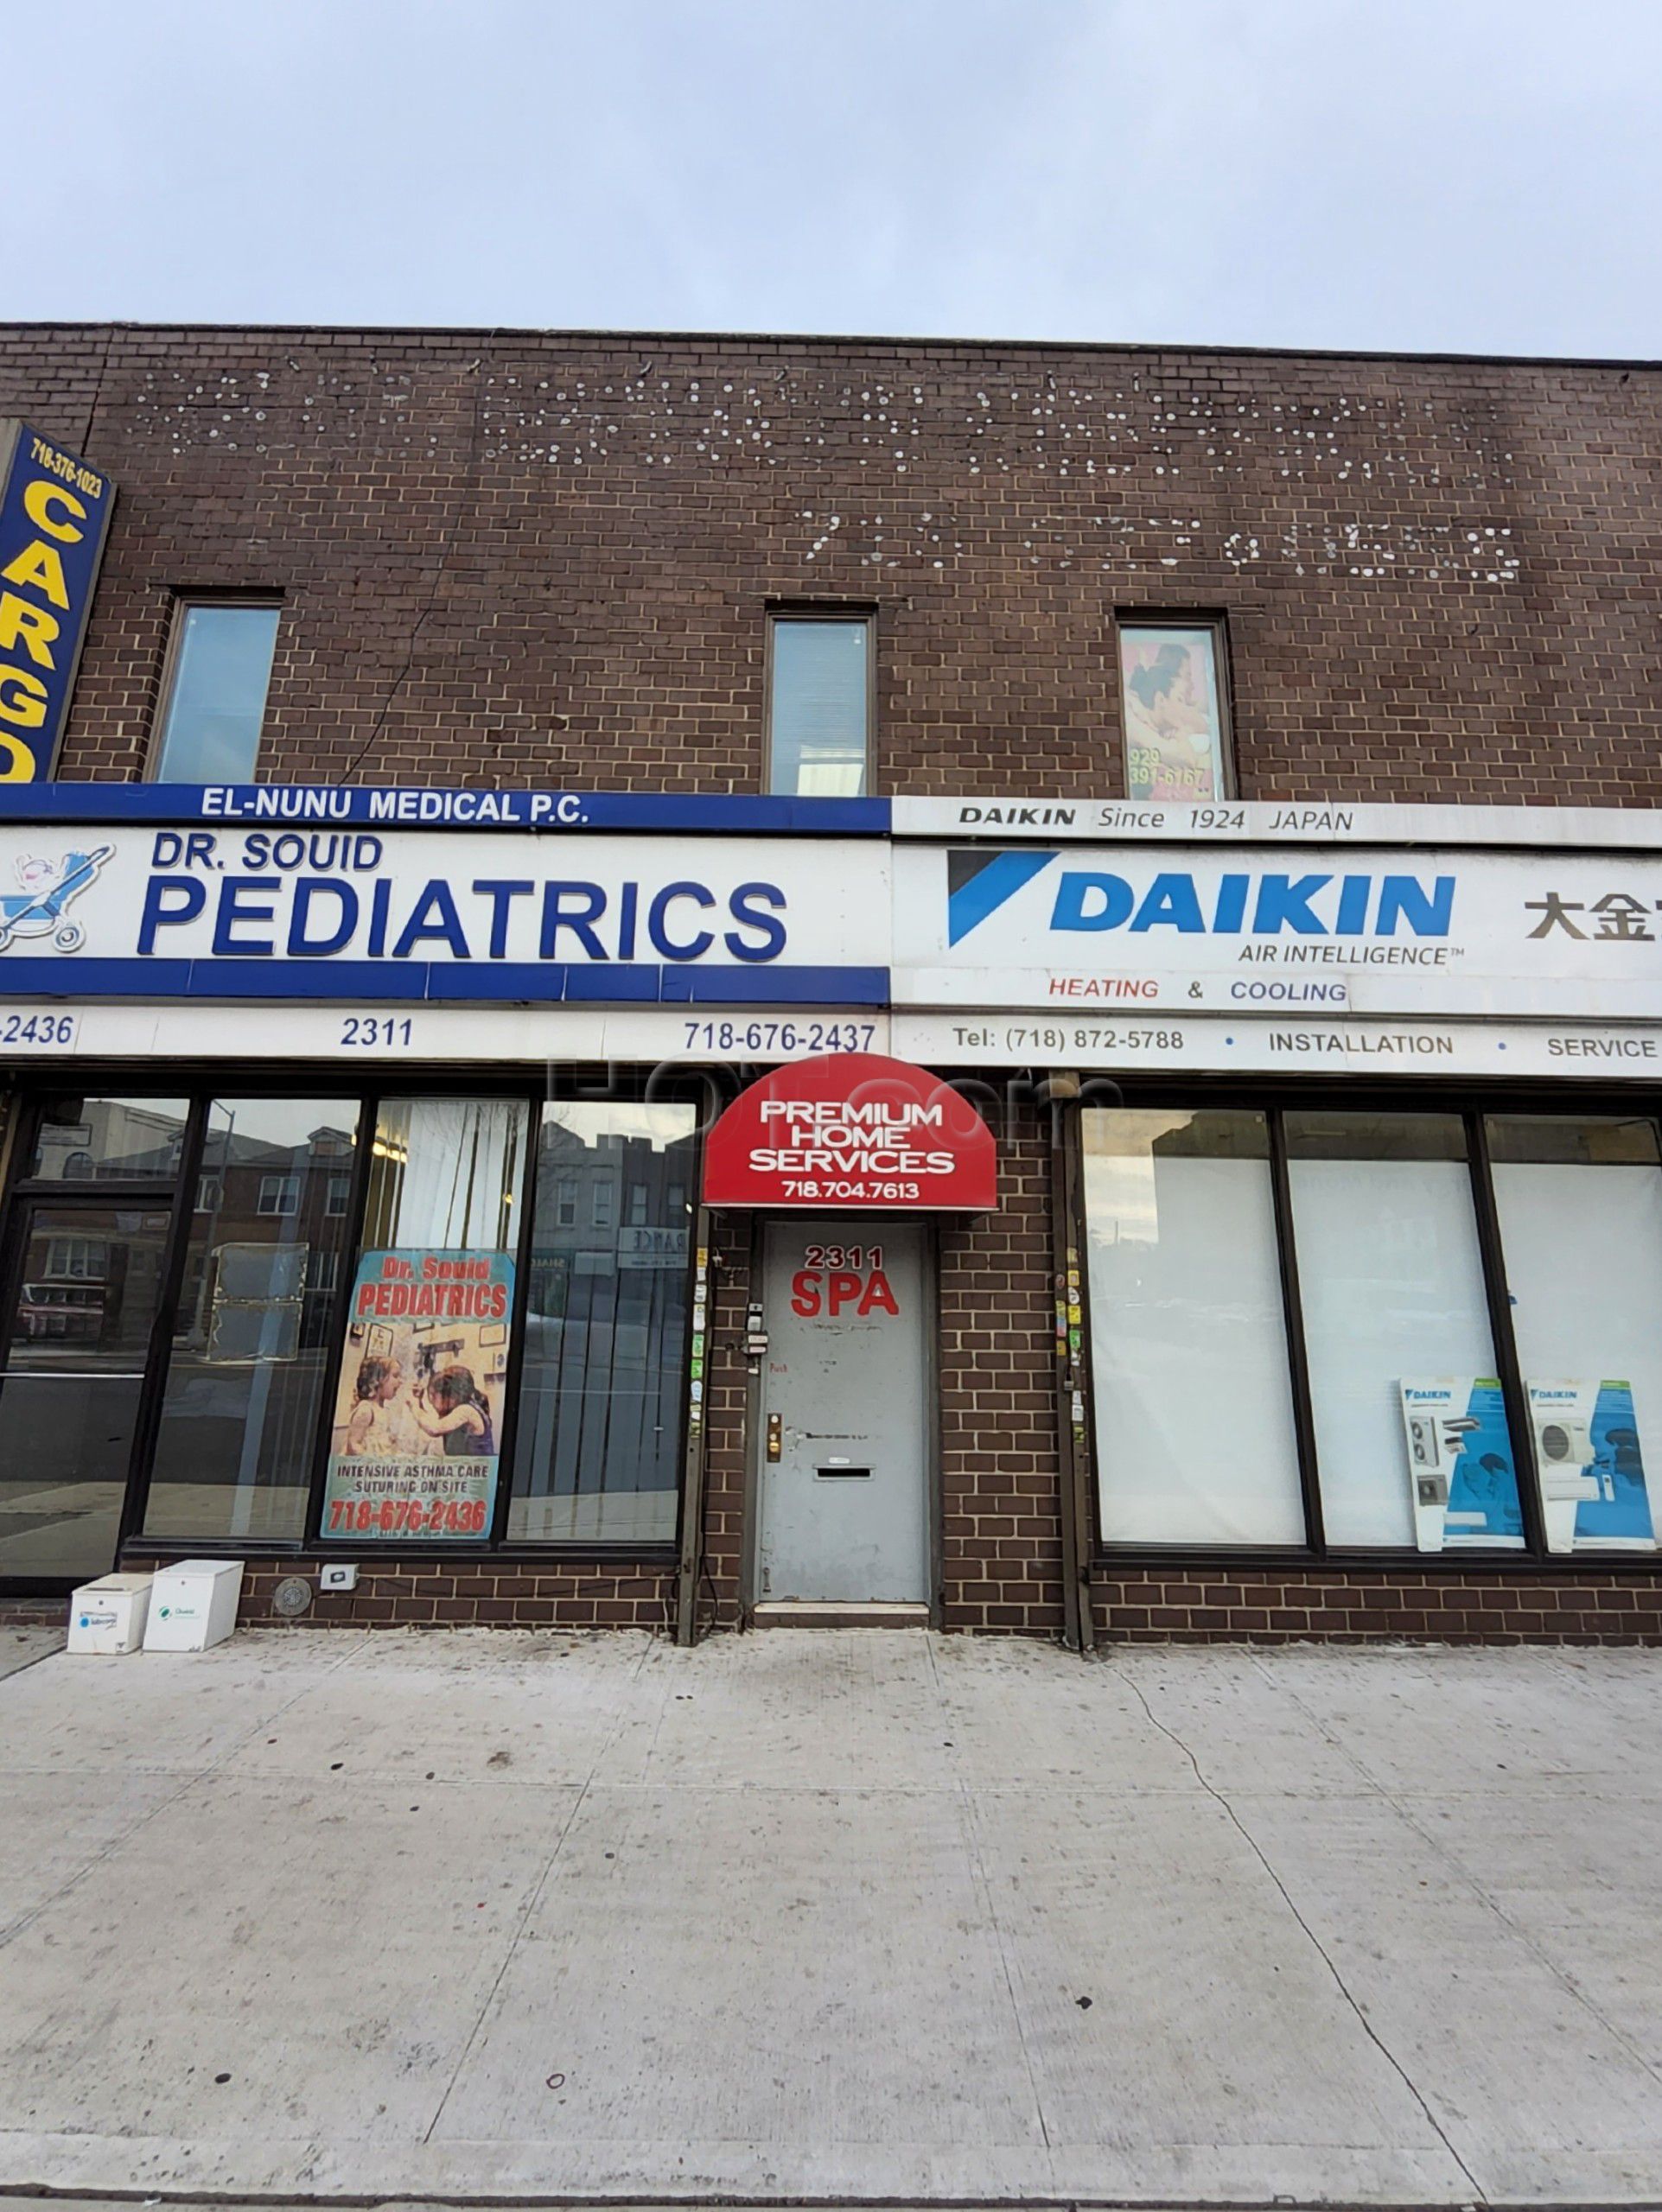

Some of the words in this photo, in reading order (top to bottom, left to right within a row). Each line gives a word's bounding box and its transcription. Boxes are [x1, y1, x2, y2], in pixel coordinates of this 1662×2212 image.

[31, 437, 103, 499] 718-376-1023
[1130, 747, 1161, 766] 929
[201, 787, 352, 818] EL-NUNU
[369, 791, 520, 823] MEDICAL
[529, 793, 589, 823] P.C.
[958, 806, 1077, 826] DAIKIN
[1098, 806, 1165, 828] Since
[1189, 809, 1246, 830] 1924
[1268, 810, 1354, 831] JAPAN
[150, 831, 225, 869] DR.
[241, 833, 384, 872] SOUID
[1049, 871, 1456, 937] DAIKIN
[1525, 891, 1662, 942] 大金
[137, 874, 787, 963] PEDIATRICS
[1238, 944, 1277, 963] AIR
[1048, 978, 1160, 999] HEATING
[1188, 981, 1204, 1000] &
[1230, 982, 1347, 1002] COOLING
[341, 1018, 412, 1046] 2311
[684, 1022, 876, 1052] 718-676-2437
[952, 1027, 996, 1047] Tel:
[1006, 1028, 1066, 1052] (718)
[1074, 1029, 1184, 1050] 872-5788
[1270, 1033, 1454, 1054] INSTALLATION
[1547, 1039, 1658, 1058] SERVICE
[760, 1100, 943, 1127] PREMIUM
[791, 1125, 912, 1149] HOME
[748, 1148, 956, 1174] SERVICES
[780, 1179, 920, 1199] 718.704.7613
[382, 1256, 414, 1280] Dr.
[423, 1256, 491, 1281] Souid
[805, 1244, 882, 1269] 2311
[357, 1283, 507, 1319] PEDIATRICS
[791, 1270, 900, 1318] SPA
[1413, 1389, 1451, 1399] DAIKIN
[1538, 1389, 1577, 1399] DAIKIN
[337, 1465, 399, 1478] INTENSIVE
[404, 1465, 454, 1478] ASTHMA
[457, 1465, 489, 1478] CARE
[354, 1480, 417, 1493] SUTURING
[420, 1481, 438, 1493] ON
[442, 1480, 468, 1493] SITE
[328, 1499, 487, 1532] 718-676-2436
